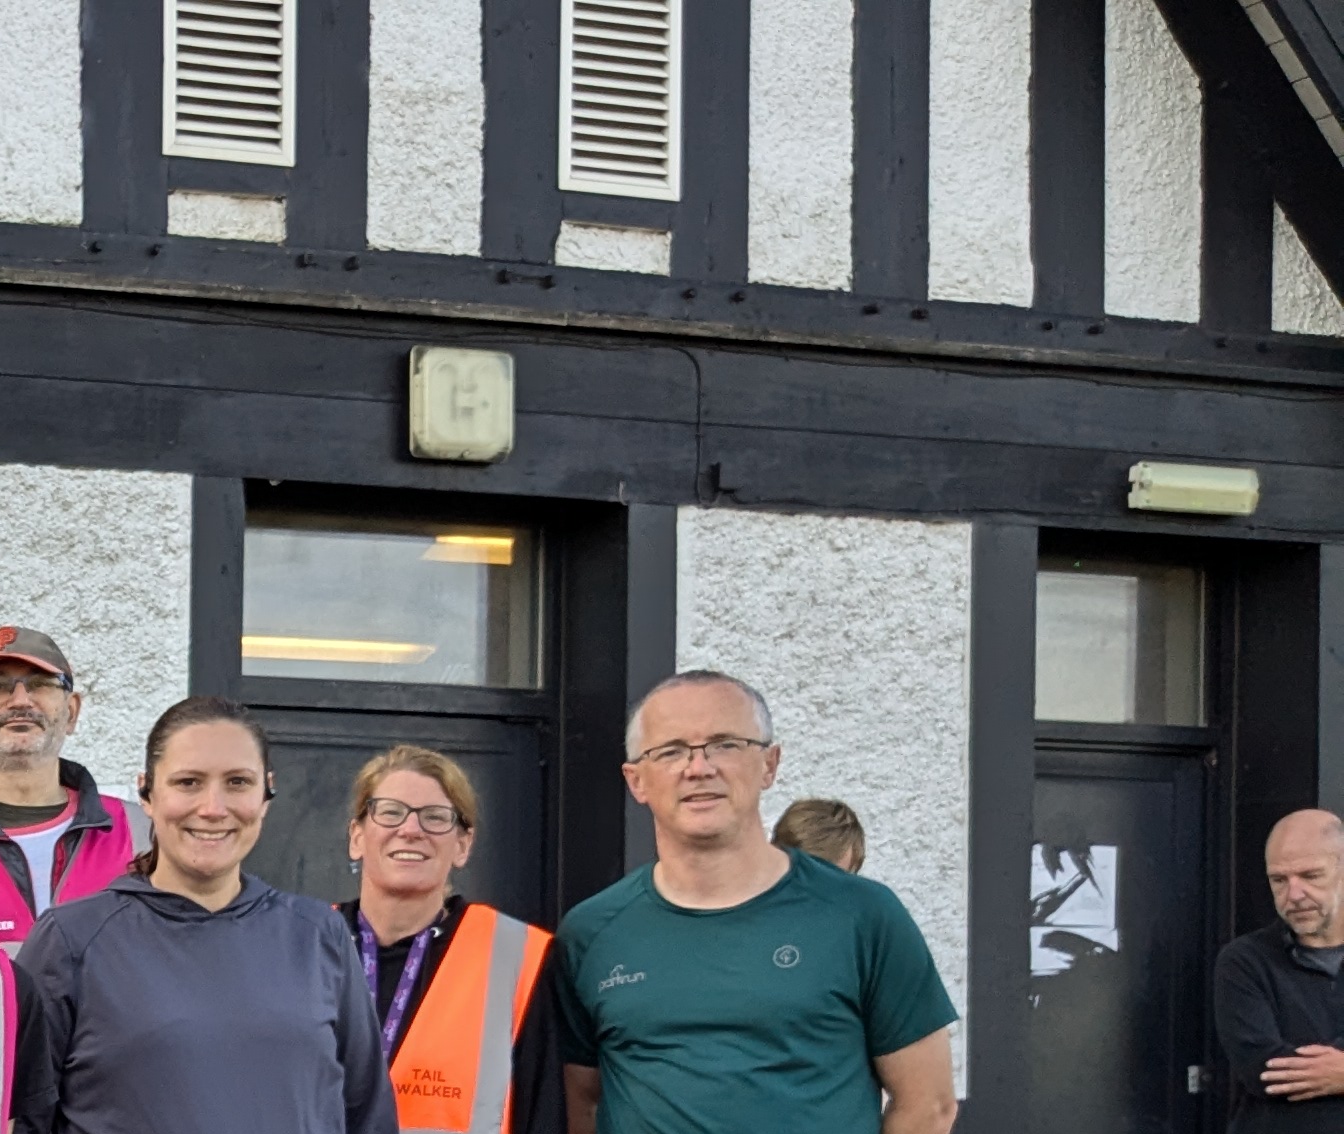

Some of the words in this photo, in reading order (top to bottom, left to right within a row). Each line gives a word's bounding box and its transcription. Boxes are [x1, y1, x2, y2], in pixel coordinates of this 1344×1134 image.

[598, 964, 646, 994] parkrun
[412, 1068, 446, 1083] TAIL
[396, 1083, 462, 1100] WALKER
